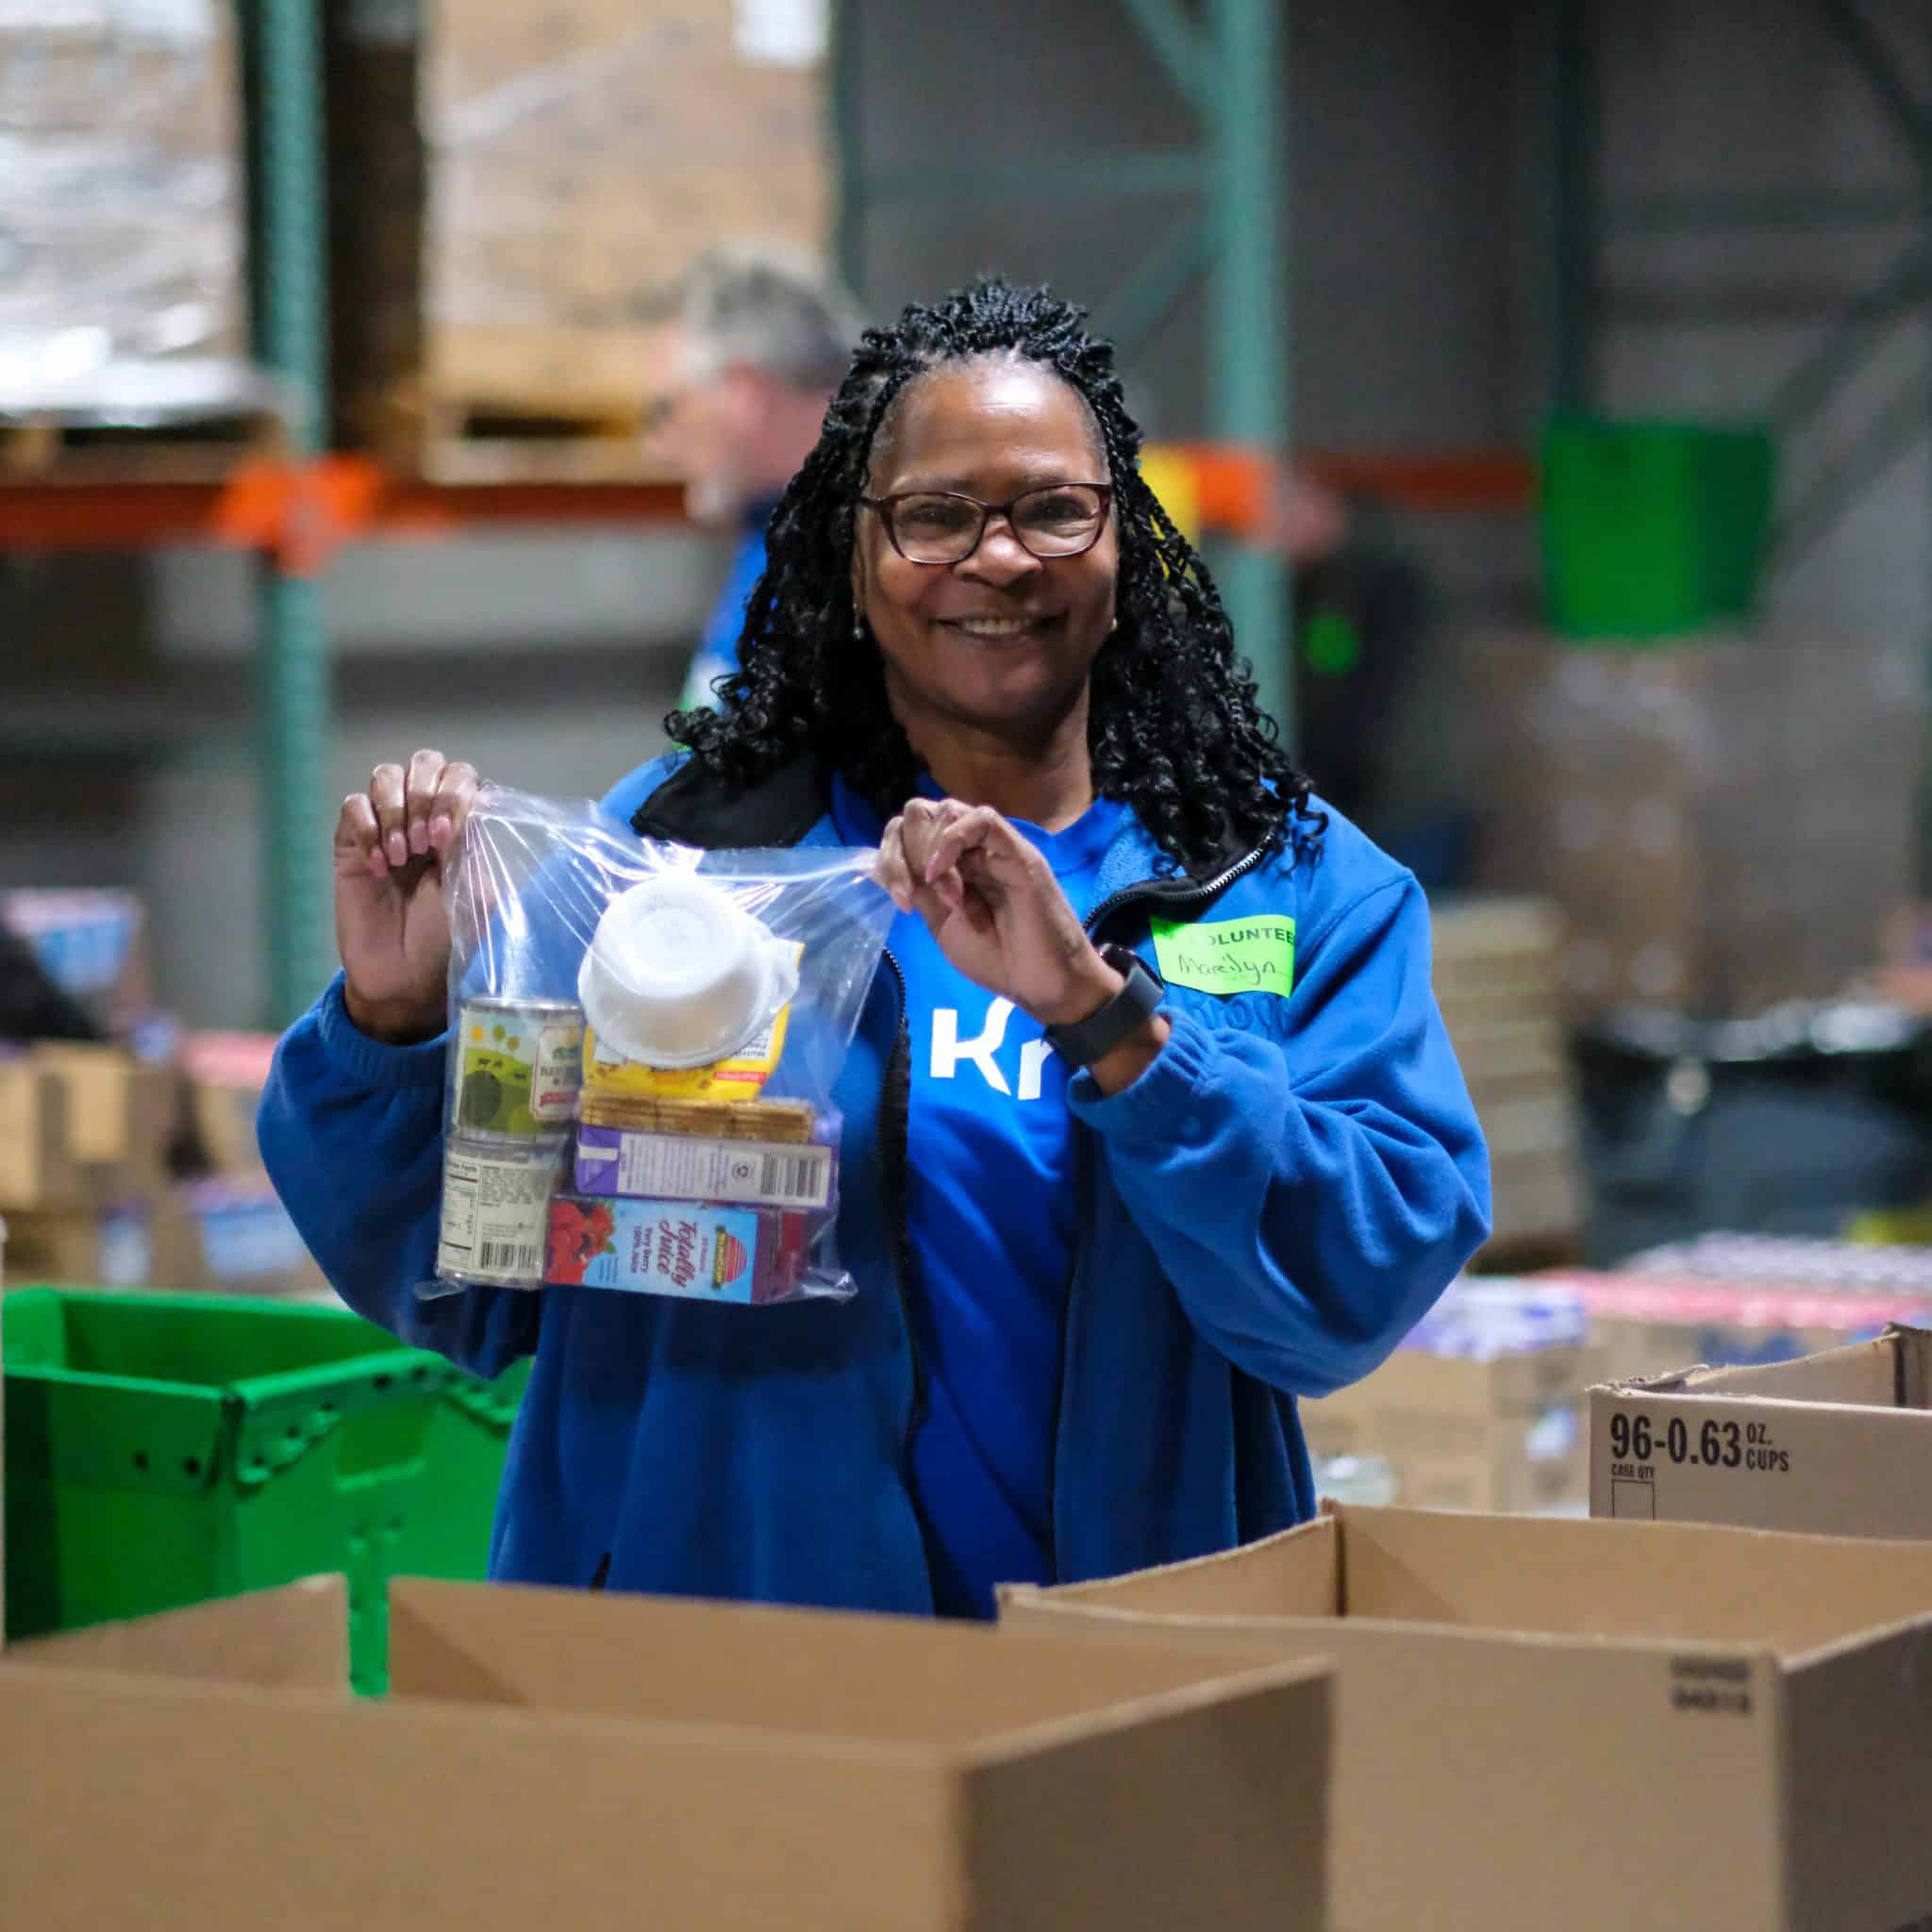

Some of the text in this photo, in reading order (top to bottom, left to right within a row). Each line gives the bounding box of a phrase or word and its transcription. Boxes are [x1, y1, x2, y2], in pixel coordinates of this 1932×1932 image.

[658, 1221, 678, 1274] Juice
[672, 1221, 697, 1287] Totally
[1610, 1412, 1774, 1468] 96-0.63 OZ.
[1746, 1448, 1790, 1472] CUPS
